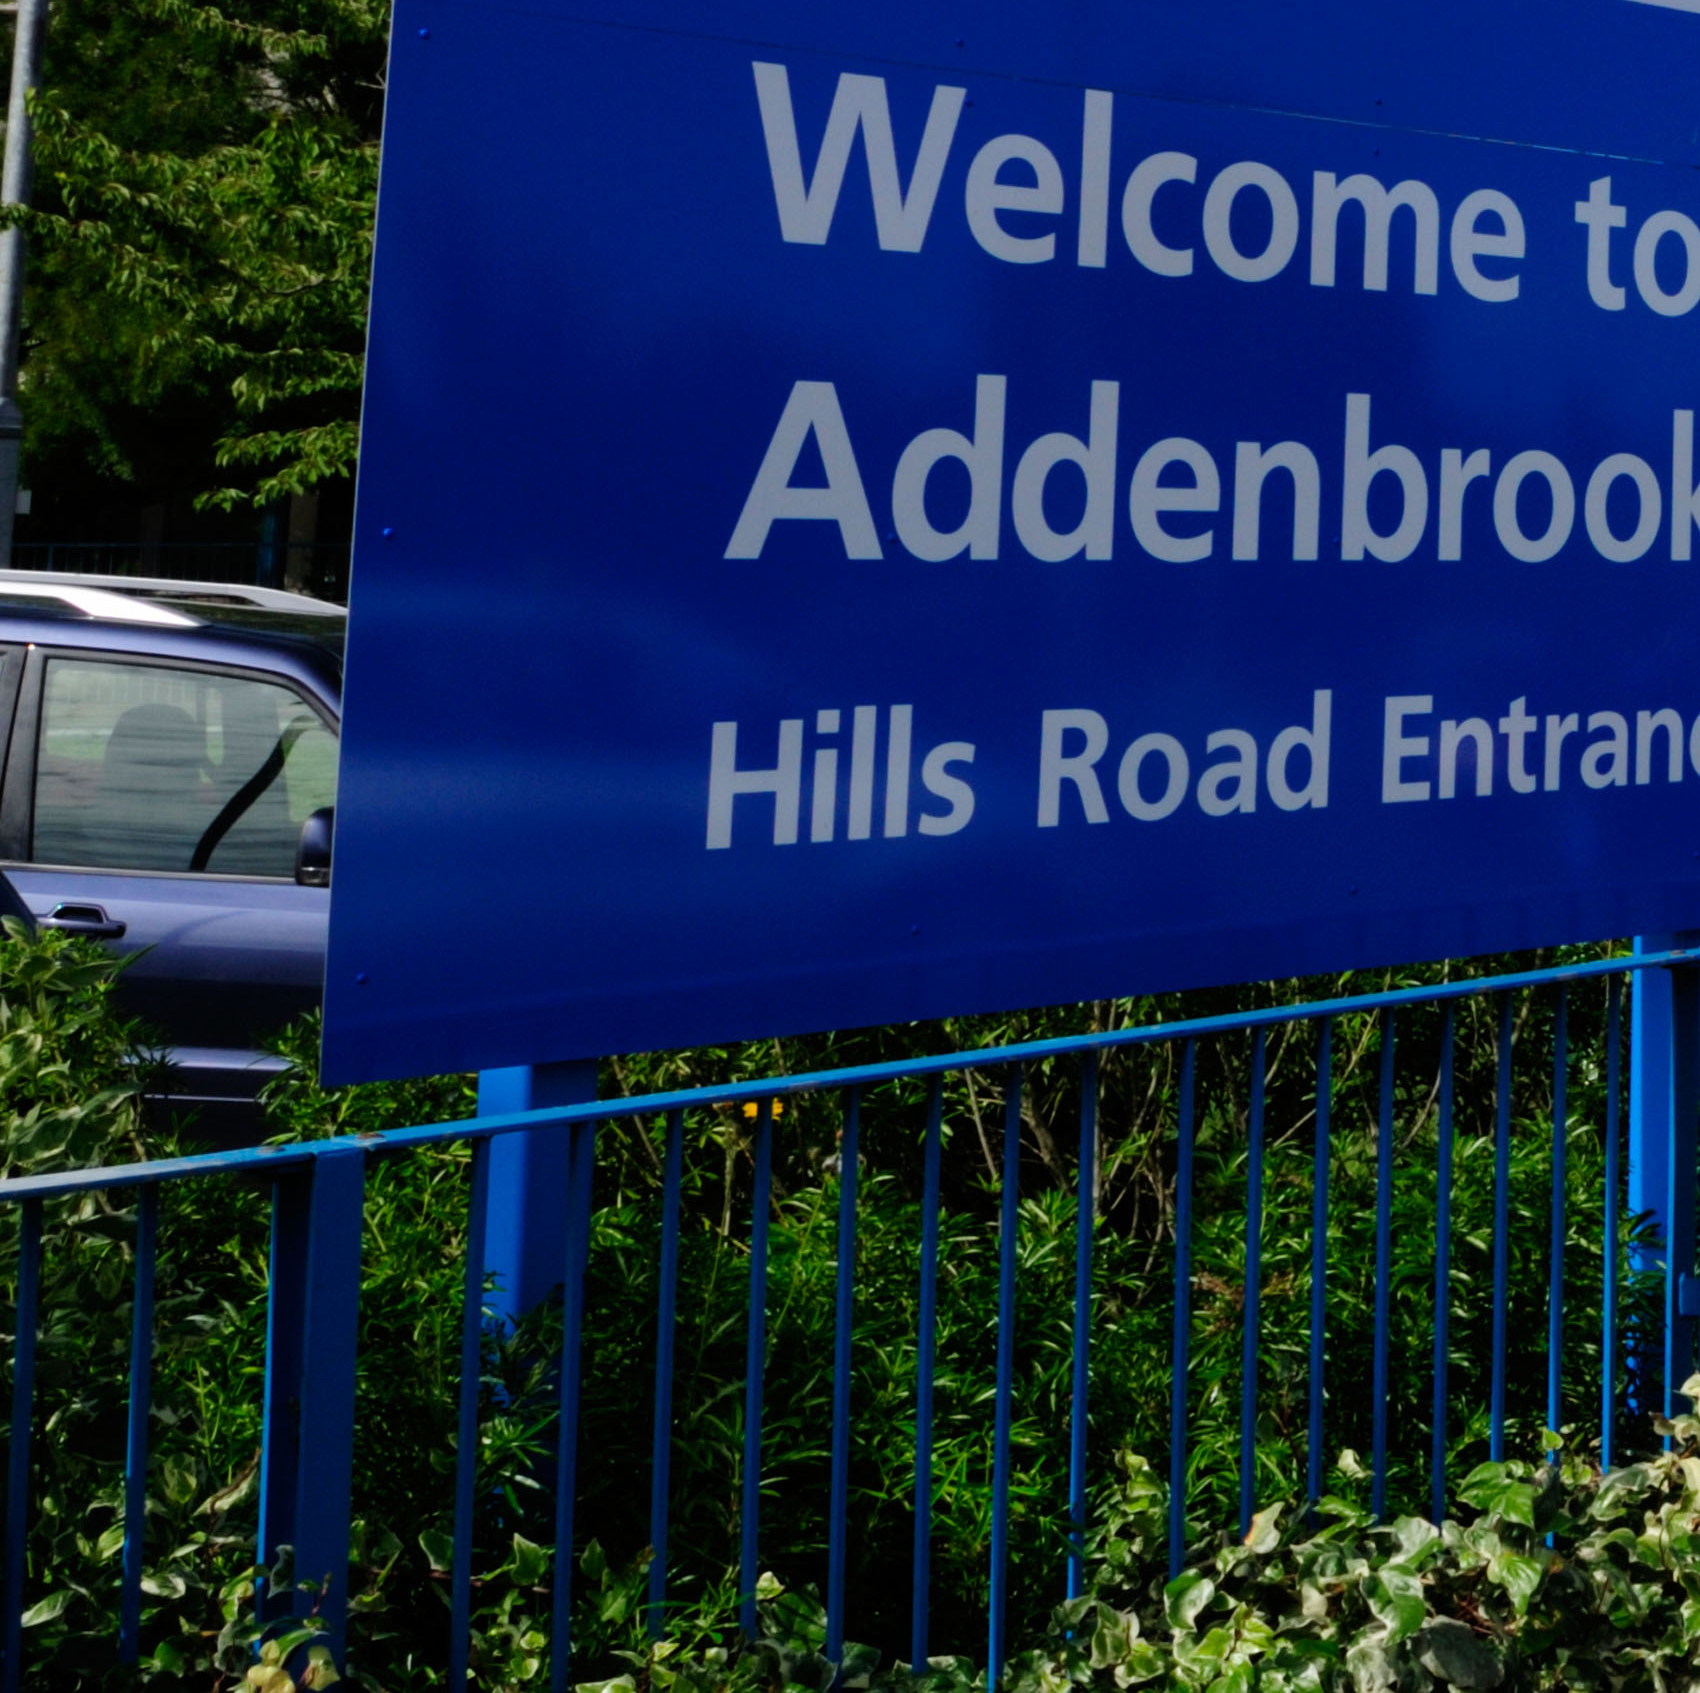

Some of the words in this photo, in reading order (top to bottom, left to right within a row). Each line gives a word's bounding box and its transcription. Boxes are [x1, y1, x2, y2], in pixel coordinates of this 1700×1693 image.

[751, 60, 1527, 303] Welcome
[705, 703, 976, 850] Hills
[1036, 688, 1332, 828] Road
